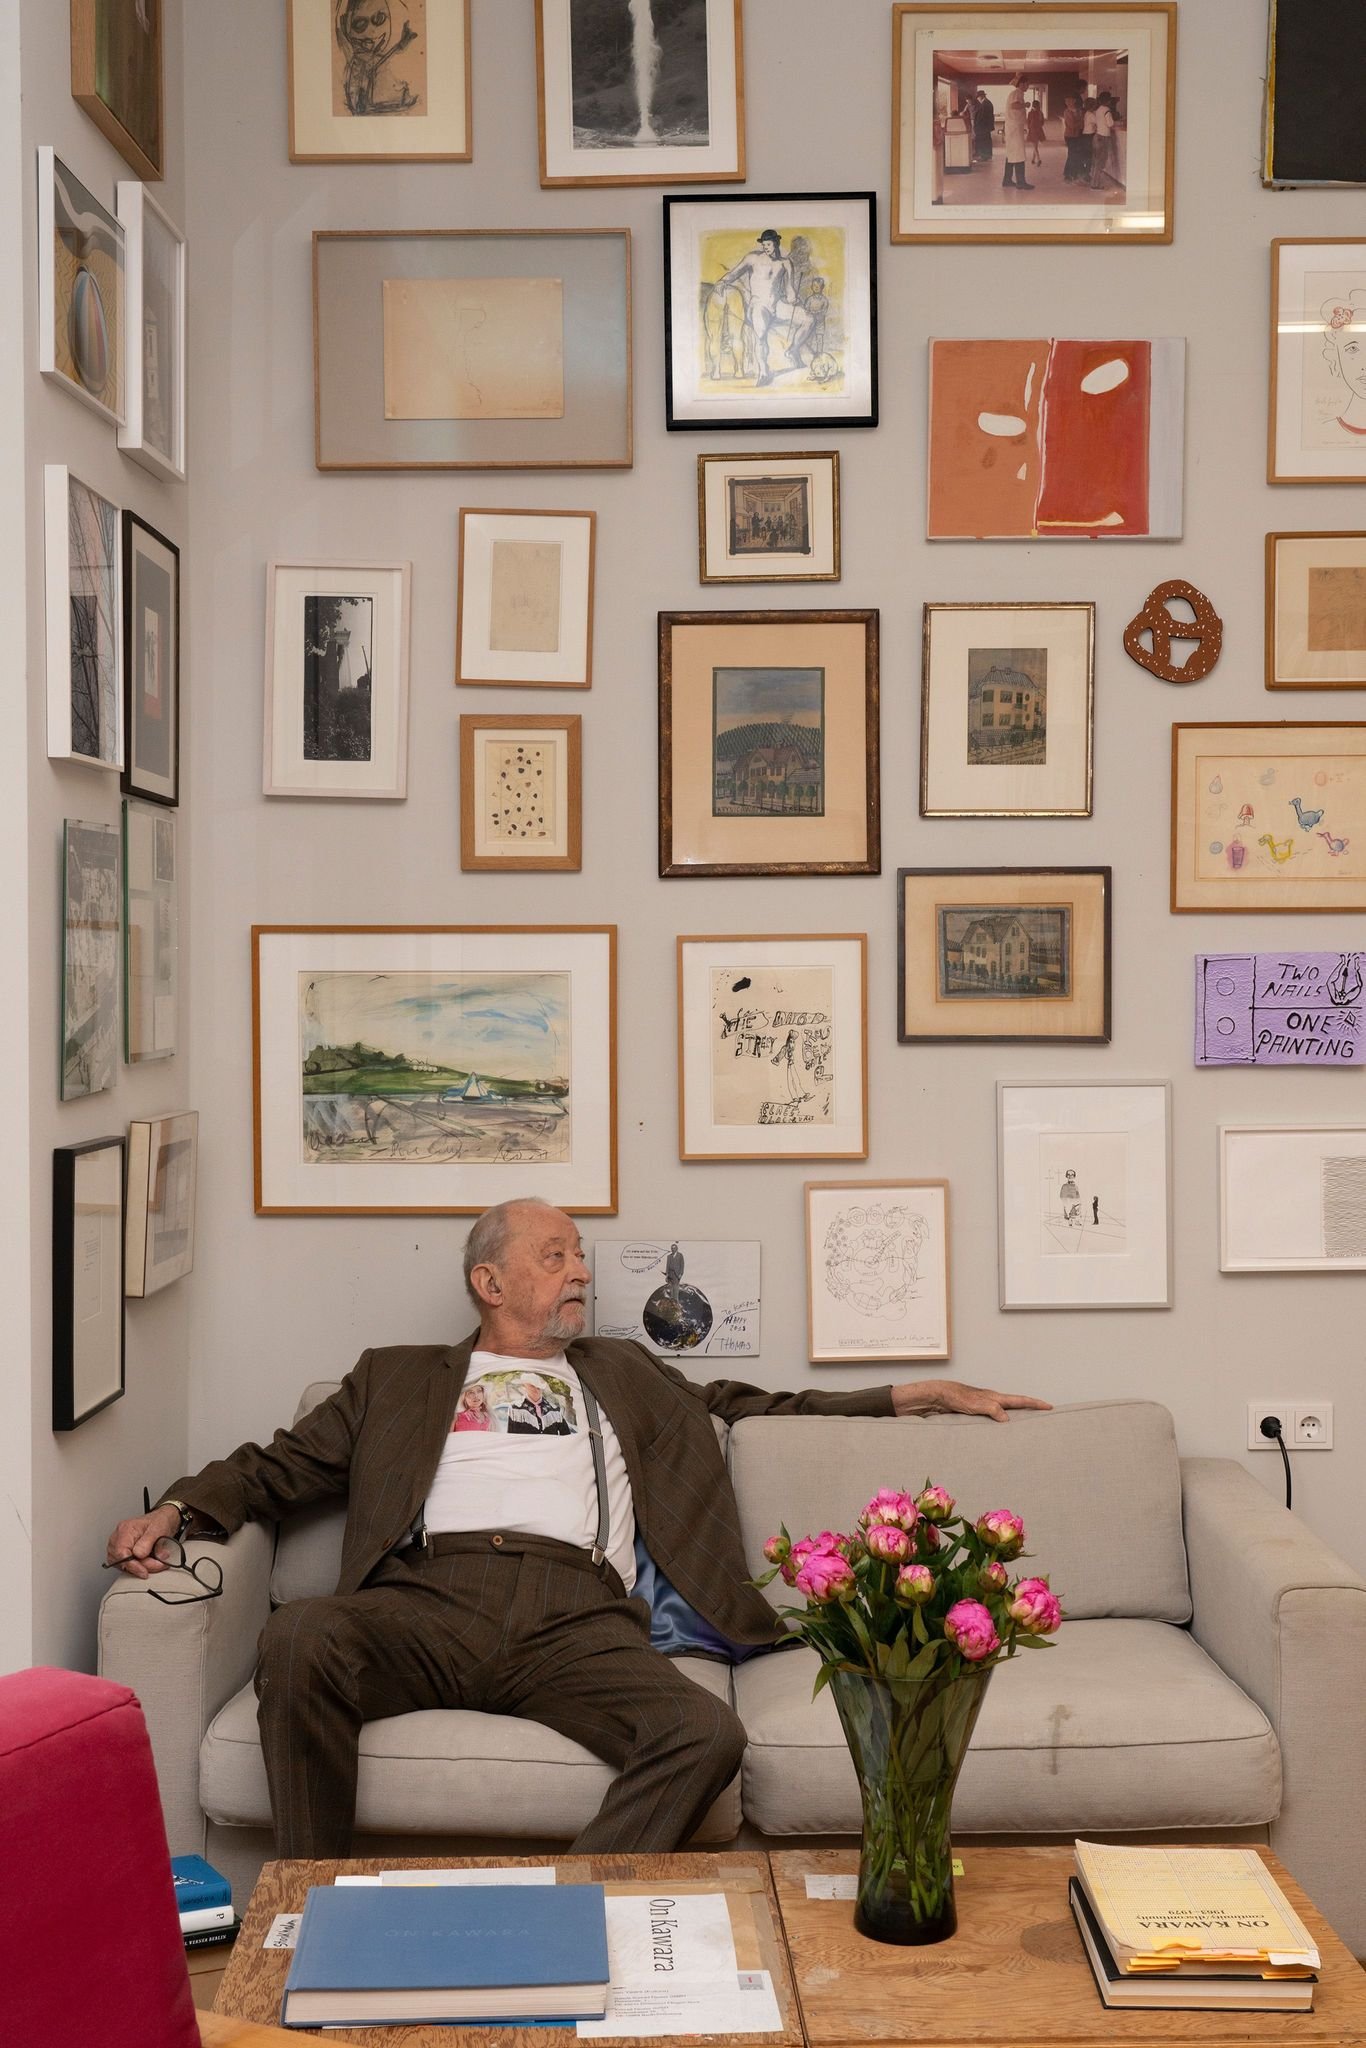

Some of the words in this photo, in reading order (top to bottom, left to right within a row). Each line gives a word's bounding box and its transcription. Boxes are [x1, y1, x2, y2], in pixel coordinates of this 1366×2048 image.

[1278, 962, 1320, 981] TWO
[1261, 981, 1323, 998] NAILS
[1286, 1011, 1337, 1034] ONE
[1255, 1028, 1355, 1058] PAINTING
[649, 1898, 676, 1916] On
[384, 1929, 417, 1937] ON
[431, 1929, 530, 1937] KAWARA
[1139, 1920, 1232, 1929] KAWARA
[1238, 1920, 1270, 1929] ON
[651, 1919, 678, 1972] Kawara
